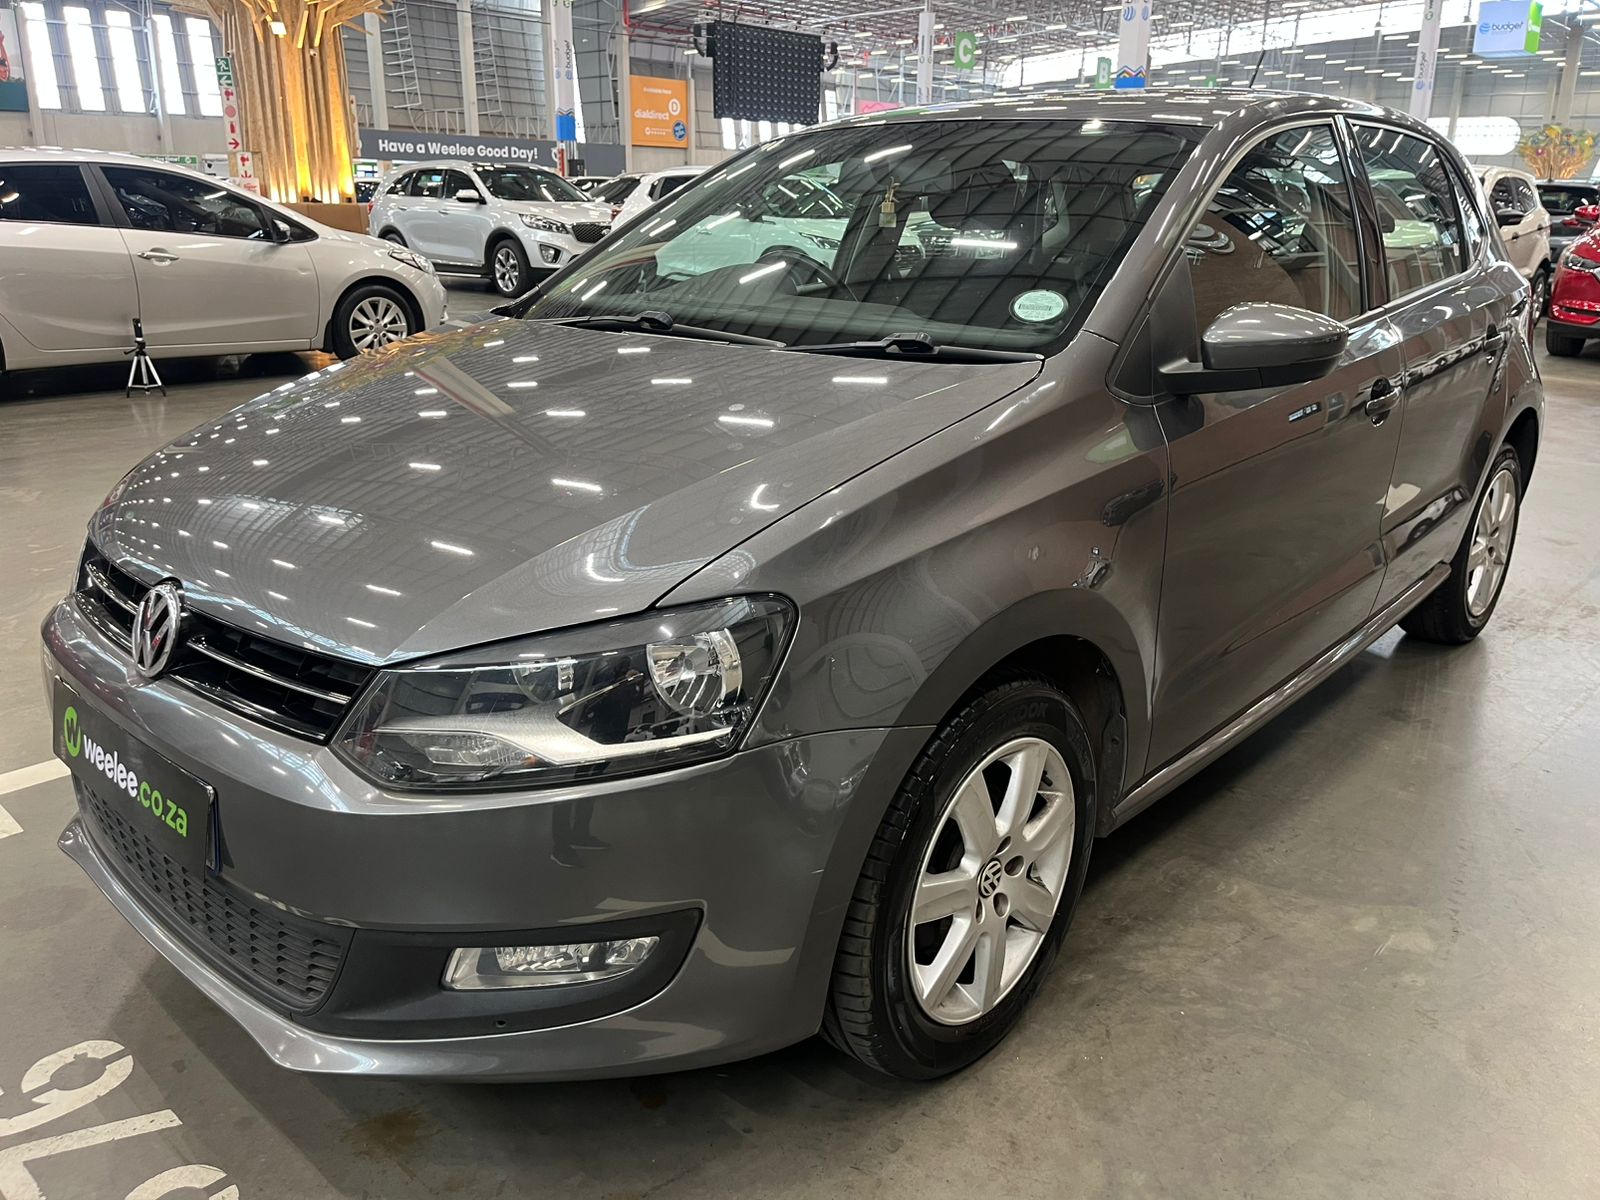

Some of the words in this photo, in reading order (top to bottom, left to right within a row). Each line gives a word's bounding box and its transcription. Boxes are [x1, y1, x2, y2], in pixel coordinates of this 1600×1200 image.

[959, 38, 972, 63] C
[1099, 62, 1108, 84] B
[378, 139, 414, 153] Have
[416, 143, 425, 154] a
[428, 142, 475, 156] Weelee
[477, 145, 508, 158] Good
[511, 146, 538, 162] Day!
[83, 734, 188, 837] weelee.co.za
